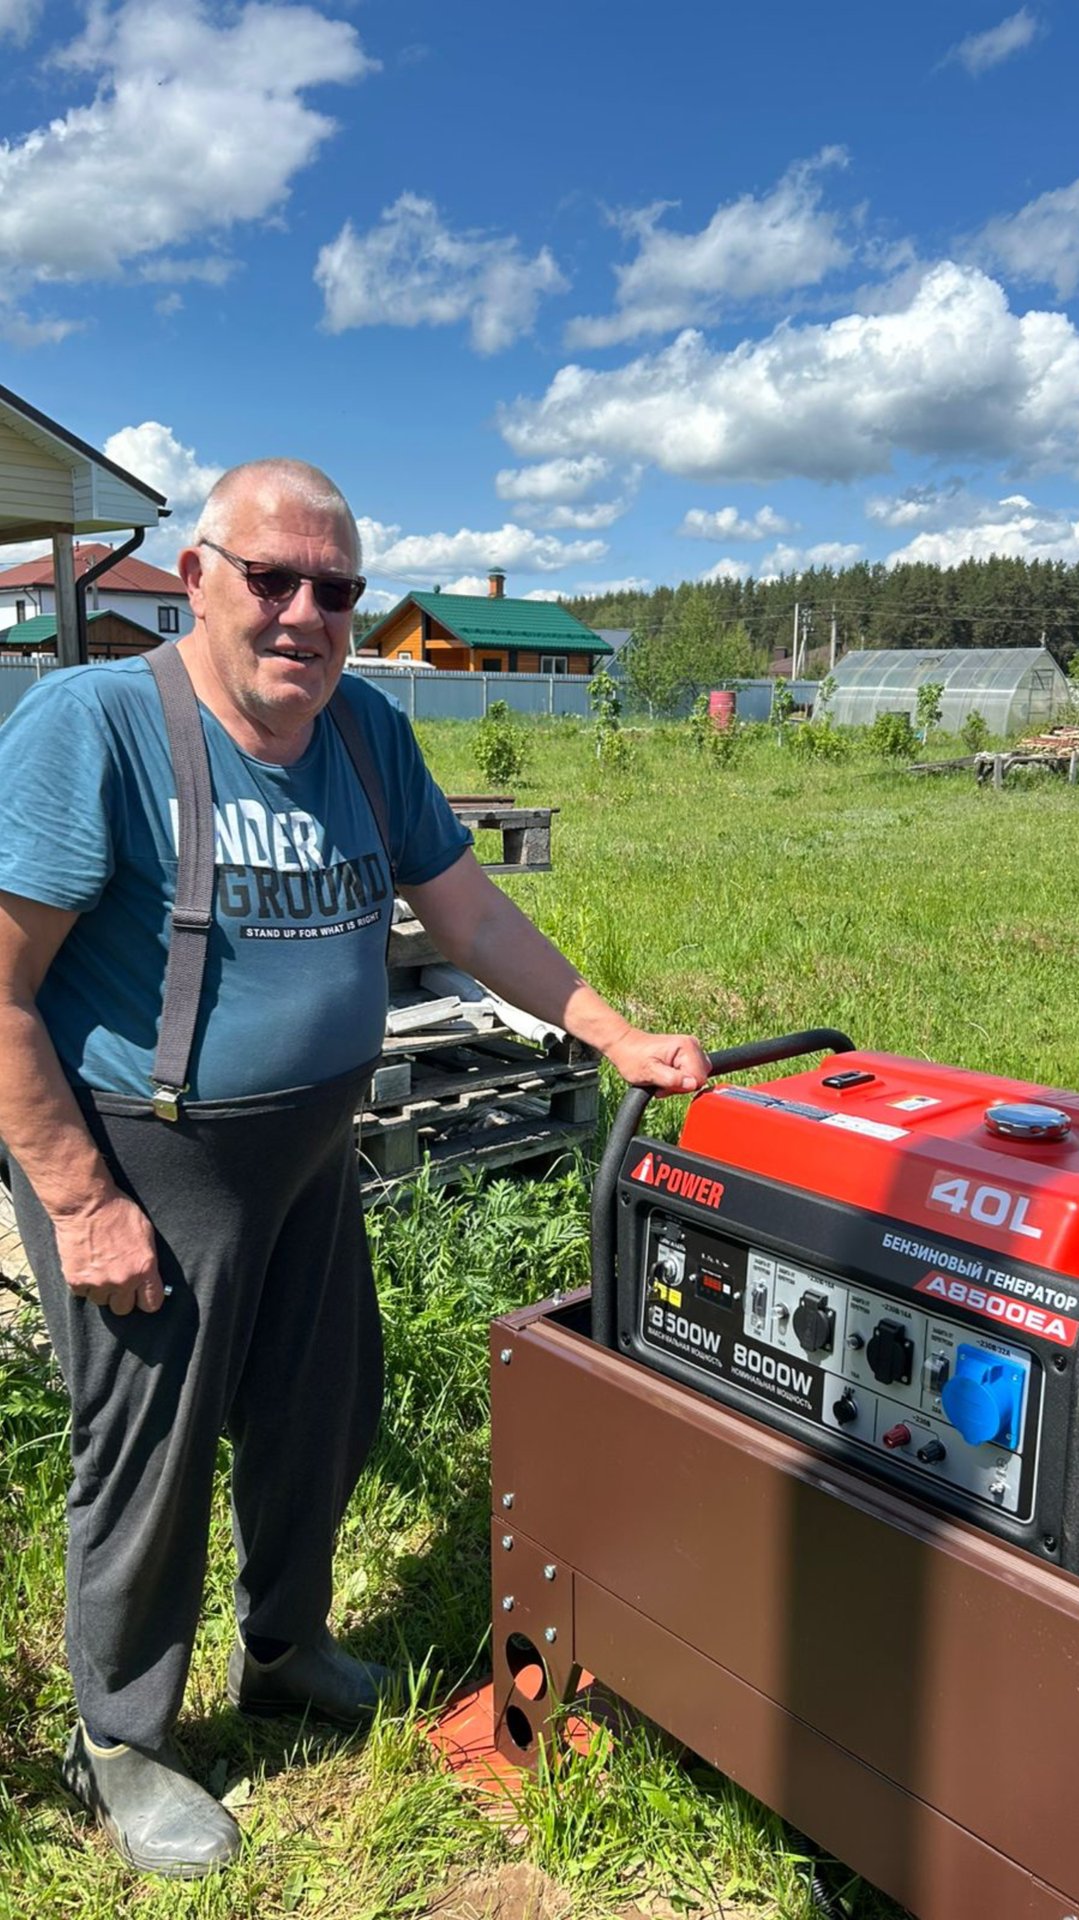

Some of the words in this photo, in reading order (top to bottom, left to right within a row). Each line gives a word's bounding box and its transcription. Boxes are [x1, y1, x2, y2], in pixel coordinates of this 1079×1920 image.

[169, 799, 325, 872] NDER
[217, 852, 388, 919] GROUND
[246, 928, 280, 938] STAND
[283, 929, 296, 938] UP
[300, 928, 318, 938] FOR
[320, 923, 344, 937] WHAT
[347, 920, 356, 930] IS
[357, 911, 379, 926] RIGHT
[931, 1178, 1043, 1240] 40L
[882, 1233, 983, 1280] БЕНЗИНОВЫЙ
[984, 1269, 1078, 1312] ГЕНЕРАТОР
[648, 1305, 721, 1353] 8500W
[926, 1276, 1067, 1341] A8500EA
[733, 1342, 813, 1396] 8000W
[776, 1386, 812, 1411] МОЩНОСТЬ
